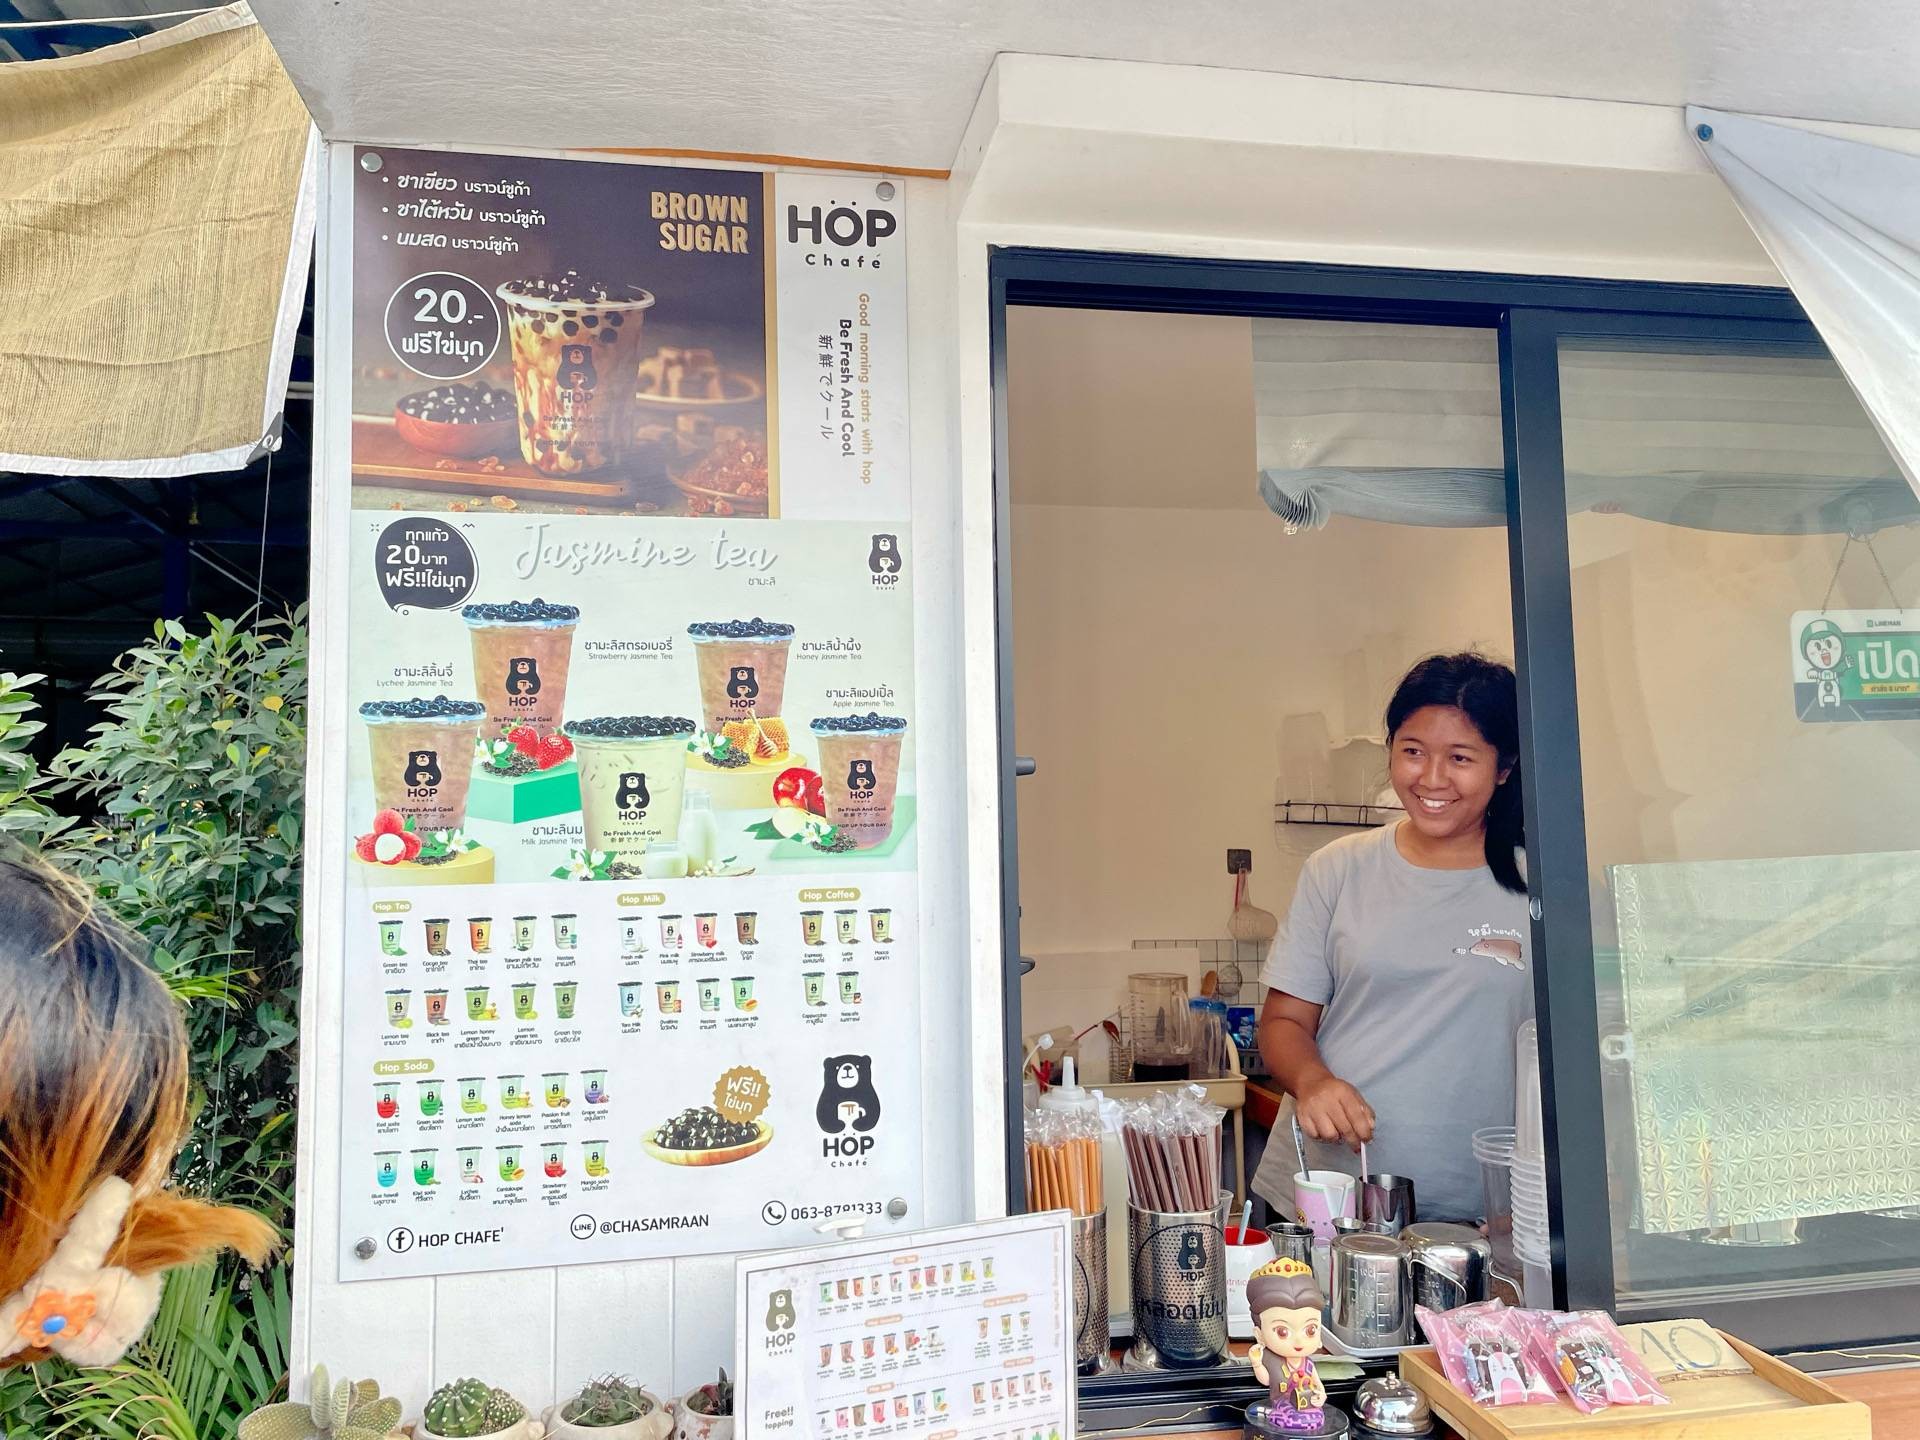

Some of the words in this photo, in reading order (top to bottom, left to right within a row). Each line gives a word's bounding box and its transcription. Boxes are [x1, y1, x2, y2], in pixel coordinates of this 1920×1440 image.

[397, 172, 458, 192] ชาเขียว
[397, 199, 473, 221] ชาไต้หวัน
[651, 191, 748, 223] BROWN
[396, 231, 447, 249] นมสด
[659, 223, 749, 254] SUGAR
[859, 293, 869, 326] Good
[839, 319, 853, 338] Be
[402, 331, 484, 362] ฟรีไข่มุก
[839, 342, 854, 384] Fresh
[858, 332, 870, 383] morning
[819, 335, 835, 440] 新鮮でクール
[840, 387, 854, 418] And
[860, 389, 870, 423] starts
[841, 422, 855, 457] Cool
[861, 429, 871, 455] with
[861, 461, 874, 485] hop
[405, 528, 449, 545] ทุกแก้ว
[517, 523, 696, 580] Jasmine
[711, 528, 778, 572] tea
[748, 577, 776, 587] ชามะลิ
[871, 574, 899, 585] HOP
[588, 652, 628, 661] Strawberry
[630, 652, 658, 660] Jasmine
[661, 652, 673, 660] Tea
[796, 653, 819, 661] Honey
[1858, 640, 1920, 680] เปิด
[376, 679, 405, 688] Lychee
[407, 679, 437, 687] Jasmine
[509, 697, 538, 706] HOP
[730, 699, 756, 708] HOP
[832, 700, 852, 708] Apple
[854, 700, 881, 708] Jasmine
[408, 788, 438, 797] HOP
[850, 791, 874, 799] HOP
[618, 810, 647, 820] HOP
[532, 824, 584, 836] ชามะลินม
[521, 837, 535, 846] Milk
[537, 837, 568, 845] Jasmine
[571, 837, 584, 845] Tea
[622, 895, 640, 904] Hop
[644, 893, 661, 902] Milk
[804, 891, 822, 901] Hop
[826, 889, 855, 899] Coffee
[375, 903, 391, 912] Hop
[395, 902, 410, 910] Tea
[380, 1063, 400, 1073] Hop
[404, 1061, 430, 1071] Soda
[727, 1075, 762, 1098] ฟรี!!
[724, 1092, 753, 1115] ไข่มุก
[574, 1223, 592, 1232] LINE
[600, 1214, 709, 1235] @CHASAMRAAN
[418, 1234, 450, 1247] HOP
[1180, 1271, 1205, 1281] HOP
[766, 1332, 796, 1349] HOP
[765, 1419, 794, 1430] topping
